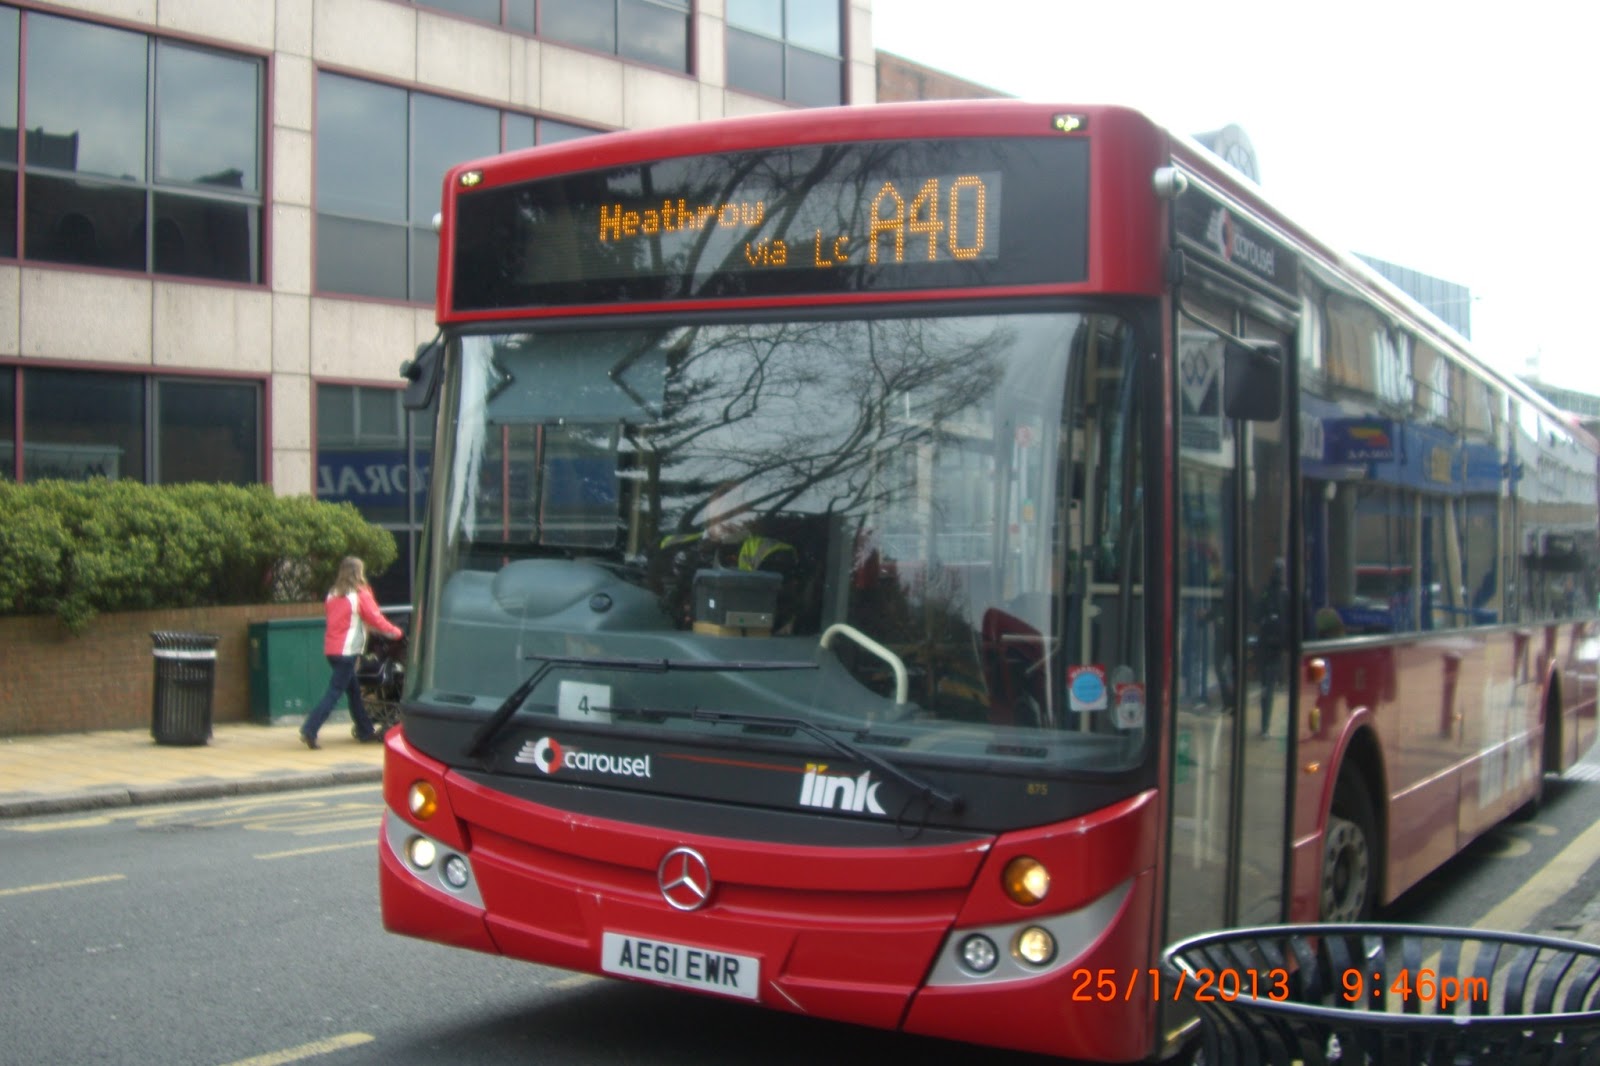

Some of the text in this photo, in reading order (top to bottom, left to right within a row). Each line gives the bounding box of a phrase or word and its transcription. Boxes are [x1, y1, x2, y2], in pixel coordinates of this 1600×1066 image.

[600, 198, 765, 242] Heathrow
[869, 175, 986, 265] A40
[745, 237, 788, 266] via
[577, 694, 590, 715] 4
[564, 749, 651, 778] carousel
[799, 763, 887, 815] link
[618, 938, 740, 988] AE61 EWR
